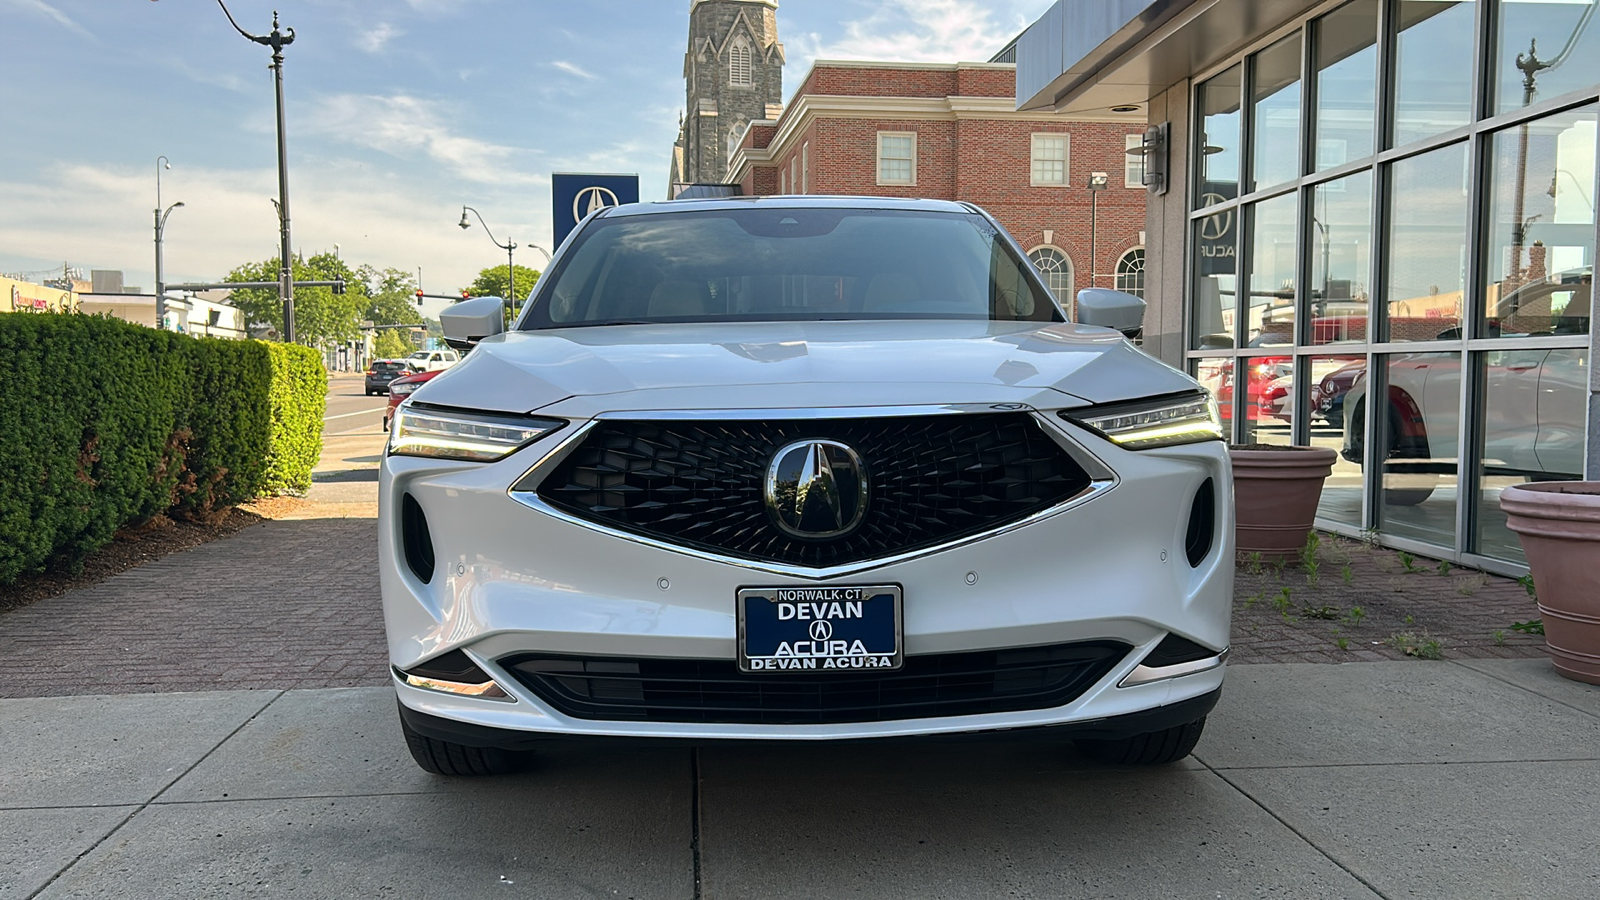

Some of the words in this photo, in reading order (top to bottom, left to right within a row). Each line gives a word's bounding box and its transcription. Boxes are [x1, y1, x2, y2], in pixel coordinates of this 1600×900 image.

[845, 589, 862, 600] CT
[778, 601, 863, 620] DEVAN
[774, 640, 868, 656] ACURA
[751, 658, 816, 670] DEVAN
[823, 657, 892, 669] ACURA
